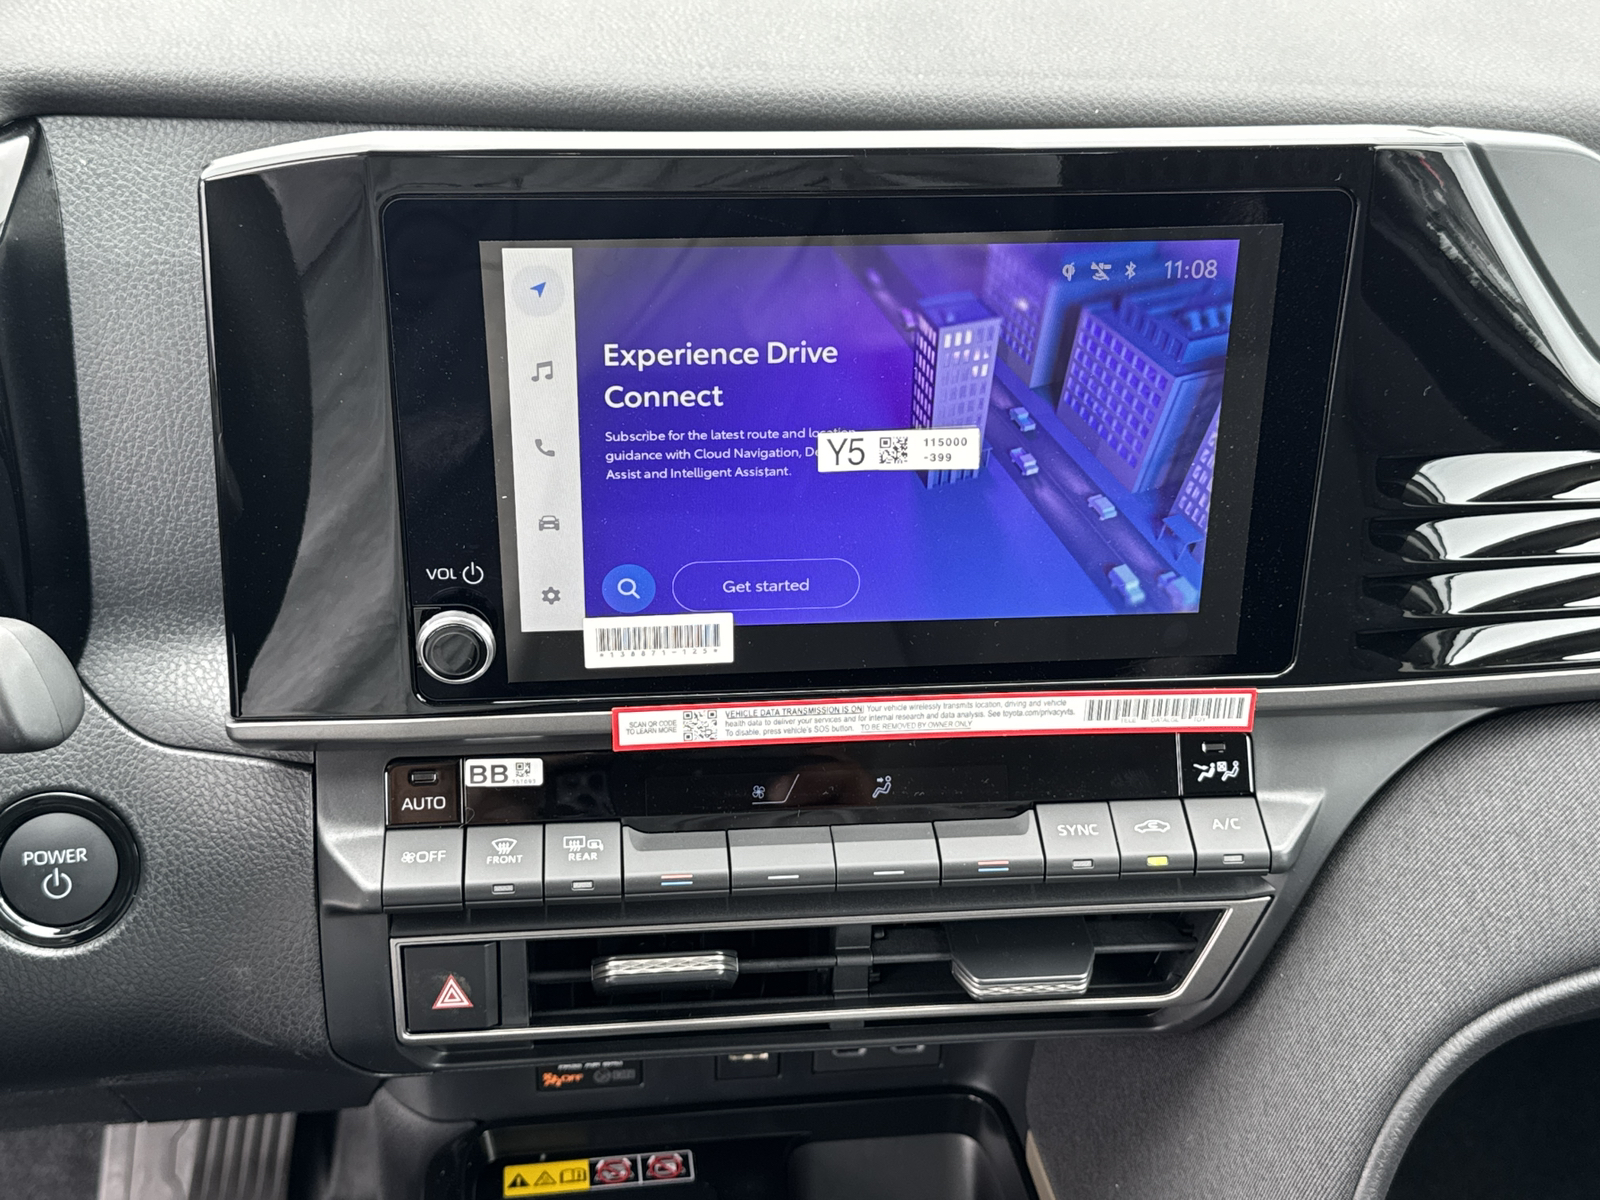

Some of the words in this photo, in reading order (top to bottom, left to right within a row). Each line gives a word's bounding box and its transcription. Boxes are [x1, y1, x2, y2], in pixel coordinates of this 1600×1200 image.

[1164, 259, 1218, 280] 11:08
[603, 342, 760, 371] Experience
[766, 340, 839, 364] Drive
[603, 385, 724, 408] Connect
[604, 430, 666, 442] Subscribe
[668, 429, 686, 441] for
[687, 429, 708, 441] the
[710, 428, 745, 440] latest
[746, 428, 780, 439] route
[781, 427, 806, 439] and
[923, 436, 968, 447] 115000
[604, 449, 663, 464] guidance
[664, 448, 692, 460] with
[693, 448, 731, 460] Cloud
[733, 447, 803, 461] Navigation,
[826, 437, 866, 467] Y5
[923, 453, 953, 463] -399
[605, 468, 642, 480] Assist
[643, 467, 668, 479] and
[670, 466, 733, 481] Intelligent
[734, 466, 793, 479] Assistant.
[425, 567, 458, 580] VOL
[722, 580, 752, 594] Get
[755, 578, 810, 592] started
[725, 709, 759, 719] VEHICLE
[760, 708, 780, 717] DATA
[782, 706, 840, 717] TRANSMISSION
[841, 705, 850, 714] IS
[866, 704, 882, 713] Your
[883, 703, 908, 712] vehicle
[908, 702, 942, 712] wirelessly
[942, 701, 974, 710] transmits
[974, 700, 1002, 709] location,
[1004, 699, 1028, 709] driving
[1028, 699, 1042, 707] and
[1043, 698, 1068, 707] vehicle
[629, 721, 648, 729] SCAN
[658, 719, 678, 727] CODE
[725, 720, 746, 728] health
[747, 719, 763, 727] data
[764, 718, 772, 726] to
[773, 718, 796, 726] deliver
[797, 717, 813, 726] your
[813, 716, 842, 724] services
[843, 715, 857, 723] and
[858, 714, 868, 722] for
[868, 713, 894, 722] internal
[895, 712, 925, 721] research
[926, 712, 939, 720] and
[940, 711, 956, 719] data
[956, 710, 986, 719] analysis.
[987, 709, 1001, 718] See
[861, 723, 871, 731] TO
[871, 722, 881, 731] BE
[882, 720, 917, 730] REMOVED
[917, 720, 927, 729] BY
[927, 719, 954, 729] OWNER
[954, 718, 973, 728] ONLY
[626, 728, 636, 736] TO
[636, 726, 658, 735] LEARN
[658, 725, 678, 734] MORE
[725, 728, 734, 737] To
[735, 727, 762, 737] disable,
[762, 727, 782, 736] press
[783, 724, 813, 734] vehicle's
[814, 724, 830, 733] SOS
[831, 723, 855, 733] button.
[469, 763, 509, 784] BB
[401, 796, 447, 811] AUTO
[1057, 823, 1100, 837] SYNC
[1212, 817, 1242, 830] A/C
[22, 847, 88, 866] POWER
[415, 850, 447, 863] OFF
[486, 854, 524, 865] FRONT
[568, 851, 598, 862] REAR
